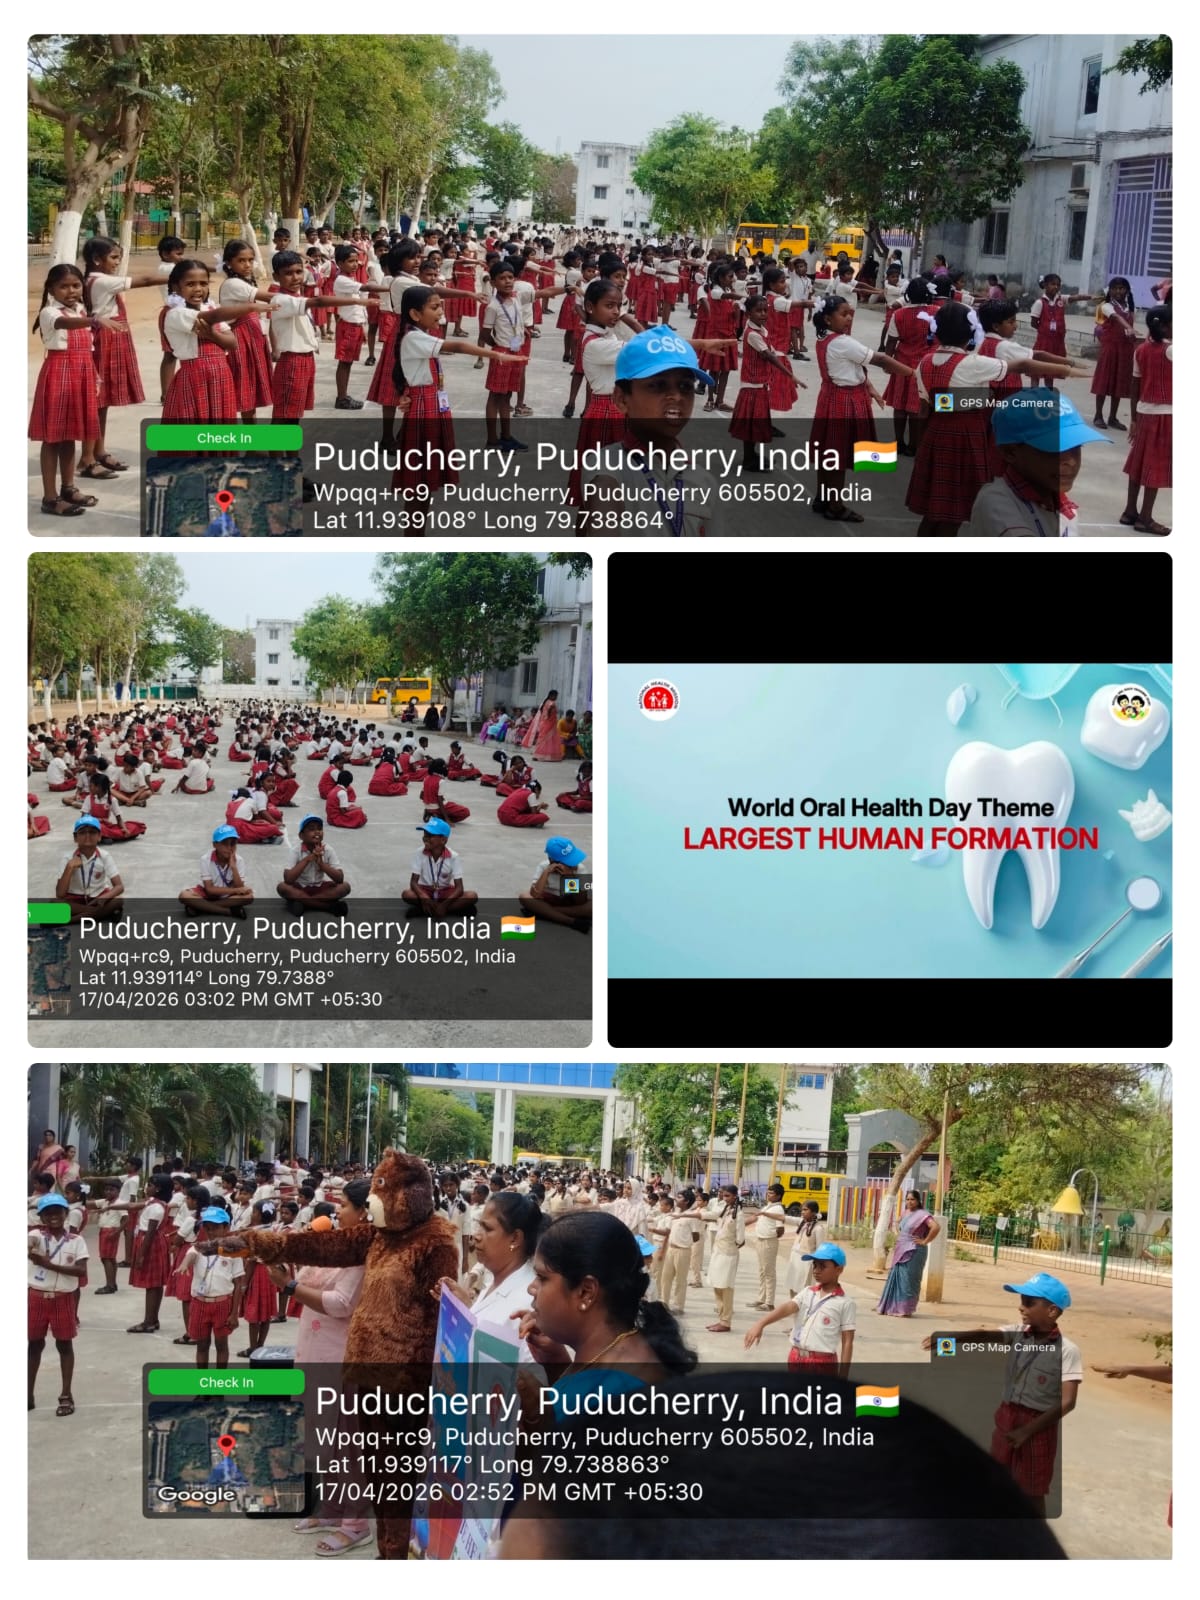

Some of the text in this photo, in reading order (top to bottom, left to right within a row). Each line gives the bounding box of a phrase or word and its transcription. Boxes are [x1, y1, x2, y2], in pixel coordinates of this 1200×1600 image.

[647, 336, 687, 354] CSS
[727, 797, 1055, 822] World Oral Health Day Theme
[684, 826, 1099, 851] LARGEST HUMAN FORMATION
